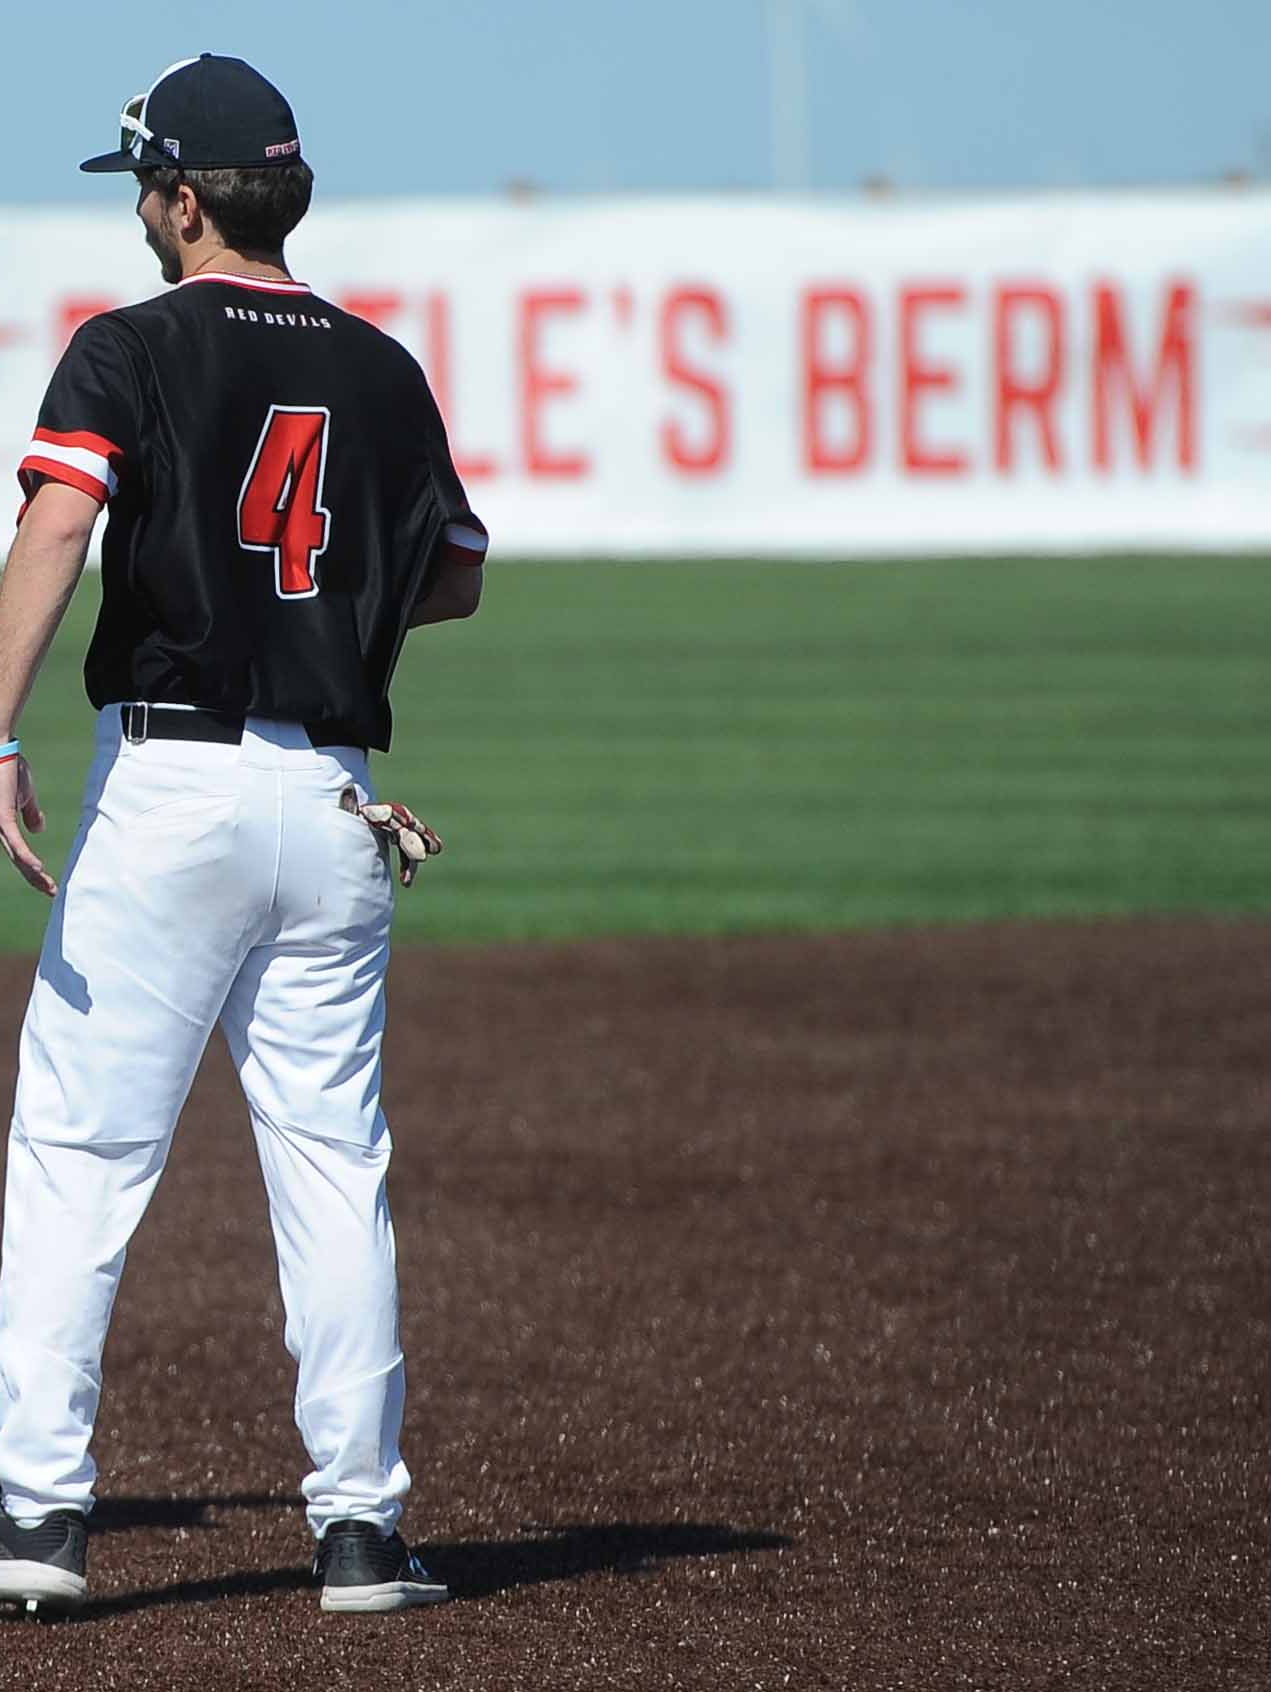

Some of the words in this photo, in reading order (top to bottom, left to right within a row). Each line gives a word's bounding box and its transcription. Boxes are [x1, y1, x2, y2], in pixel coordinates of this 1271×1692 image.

[224, 306, 259, 322] RED
[263, 312, 331, 328] DEVILS
[801, 279, 1198, 478] BERM
[236, 404, 331, 600] 4
